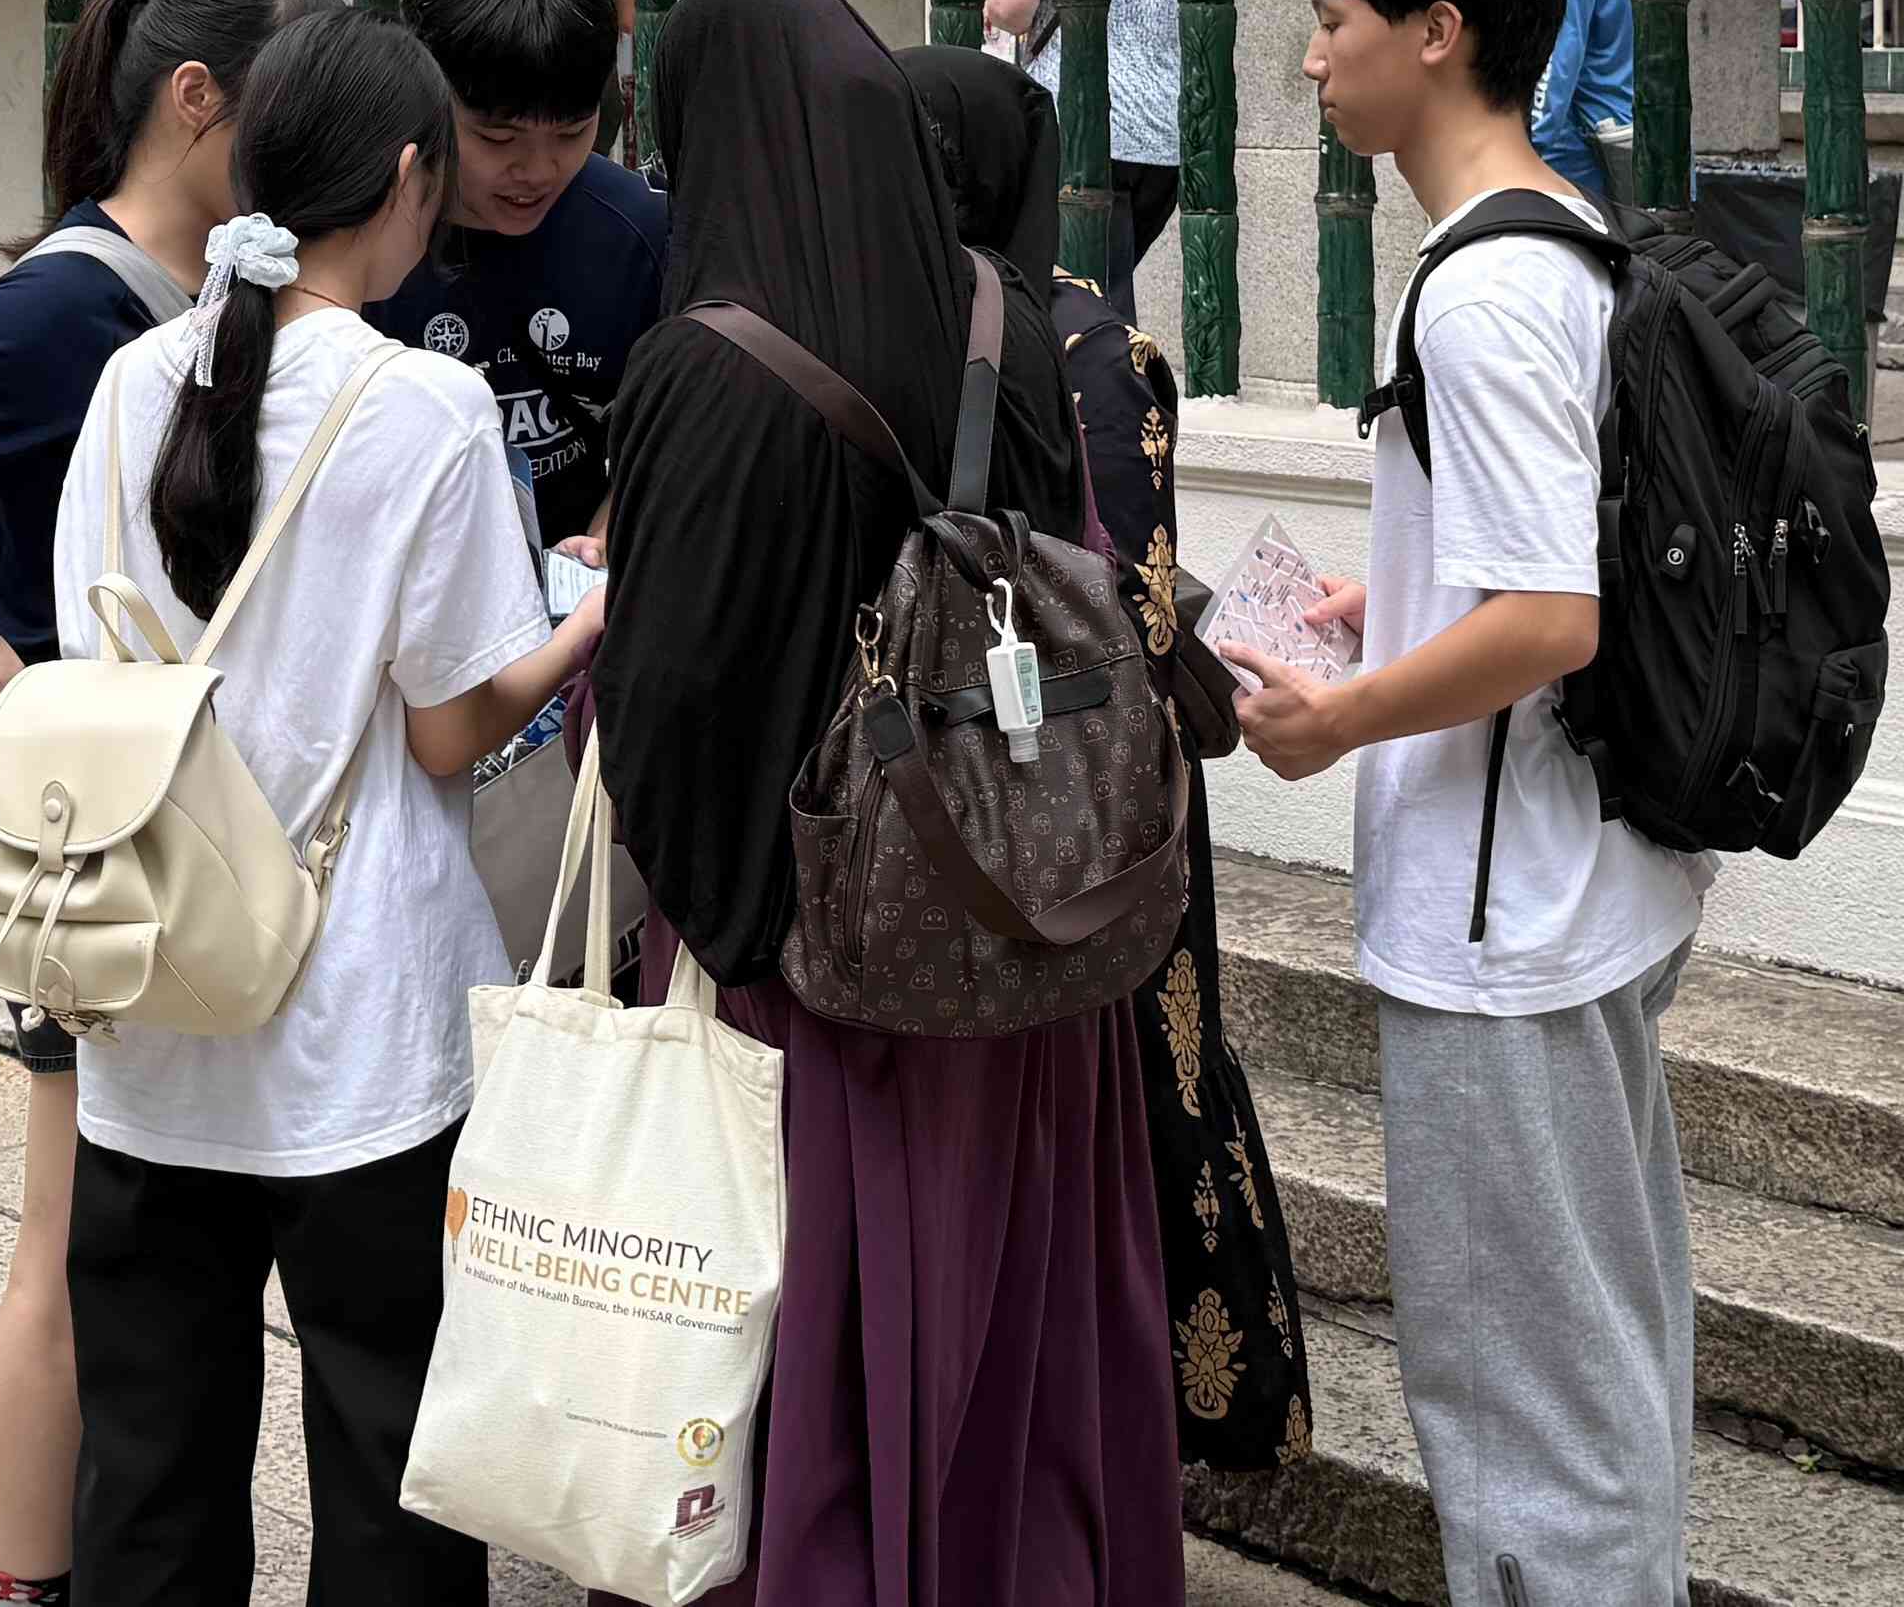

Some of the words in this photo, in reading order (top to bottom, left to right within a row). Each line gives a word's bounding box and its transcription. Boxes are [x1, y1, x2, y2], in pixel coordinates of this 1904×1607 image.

[576, 352, 602, 372] Bay
[471, 1196, 555, 1244] ETHNIC
[563, 1222, 713, 1273] MINORITY
[469, 1229, 622, 1293] WELL-BEING
[630, 1272, 753, 1316] CENTRE
[507, 1279, 517, 1291] of
[520, 1281, 535, 1296] the
[537, 1286, 570, 1305] Health
[572, 1294, 610, 1313] Bureau,
[613, 1302, 630, 1317] the
[632, 1307, 673, 1324] HKSAR
[676, 1314, 744, 1336] Government
